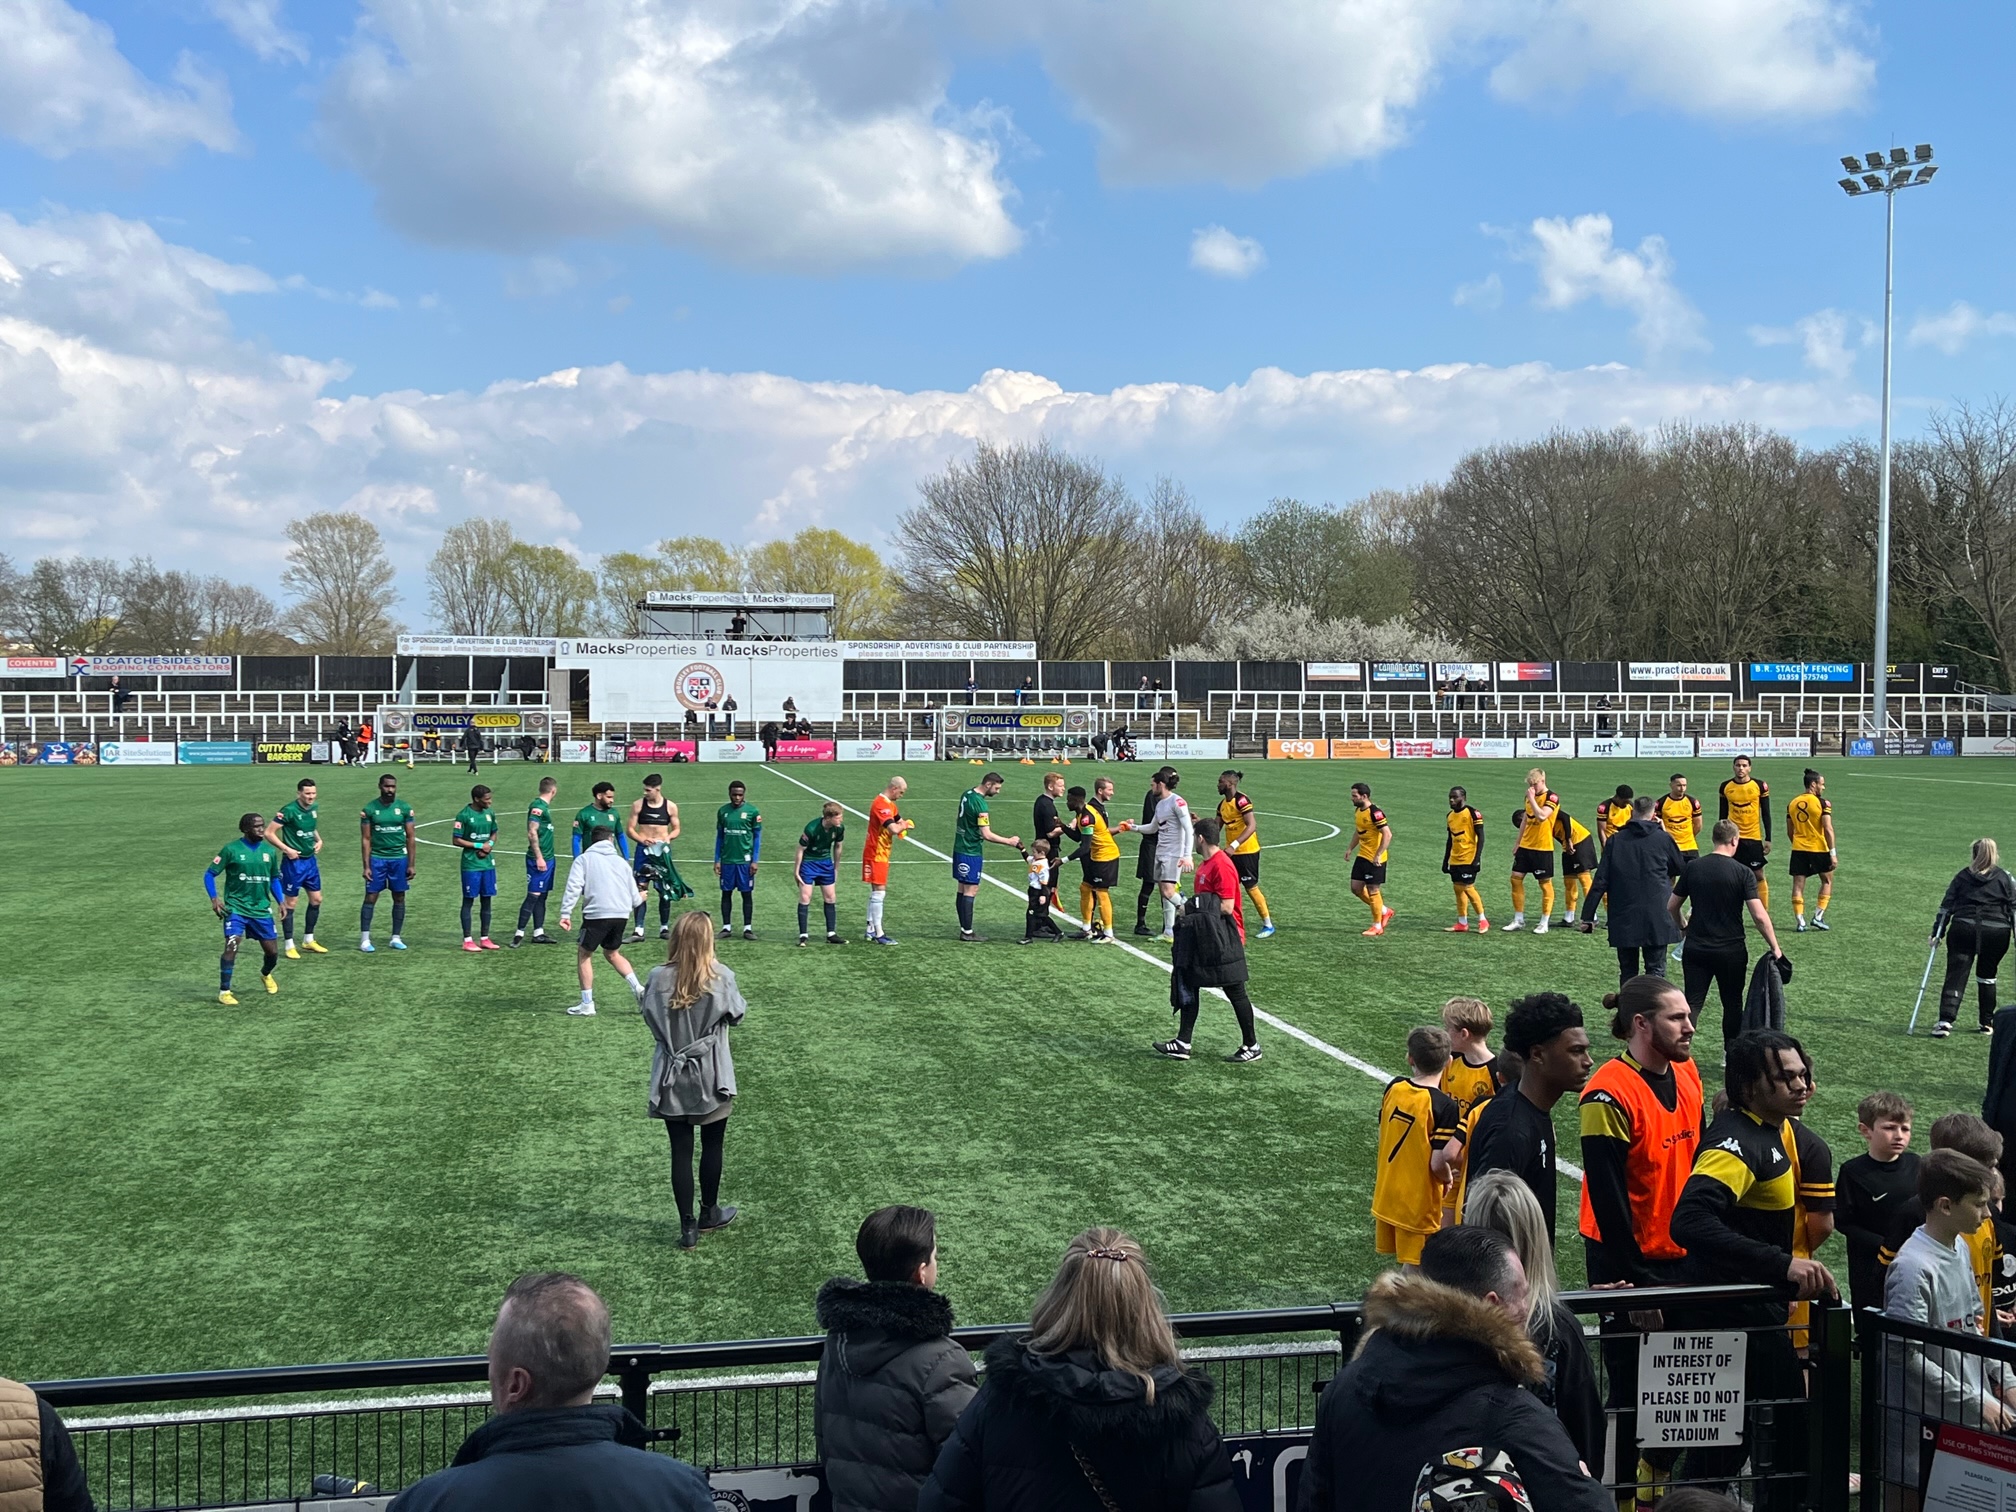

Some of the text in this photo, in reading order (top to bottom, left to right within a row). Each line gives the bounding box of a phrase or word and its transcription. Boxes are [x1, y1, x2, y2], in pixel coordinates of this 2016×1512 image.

[848, 642, 902, 650] SPONSORSHIP,
[1755, 665, 1849, 673] B.R. STACEY FENCING
[1803, 673, 1829, 681] 575749
[416, 714, 518, 725] BROMLEY SIGNS
[969, 715, 1060, 725] BROMLEY SIGNS
[257, 743, 283, 752] CUTTY
[284, 743, 312, 752] SHARP
[1280, 741, 1315, 758] ersg
[1534, 740, 1559, 749] CLARITY
[1593, 741, 1612, 753] nrt
[267, 752, 303, 761] BARBERS
[1796, 800, 1810, 823] 8
[1388, 1105, 1416, 1163] 7
[1673, 1336, 1713, 1349] IN THE
[1653, 1354, 1732, 1368] INTEREST OF
[1667, 1372, 1716, 1386] SAFETY
[1642, 1390, 1740, 1405] PLEASE DO NOT
[1655, 1409, 1727, 1423] RUN IN THE
[1661, 1427, 1719, 1442] STADIUM
[1942, 1438, 1955, 1447] USE
[1956, 1442, 1966, 1450] OF
[1967, 1445, 1982, 1455] THIS
[1978, 1439, 2016, 1454] Regulation
[1964, 1470, 1983, 1480] PLEASE
